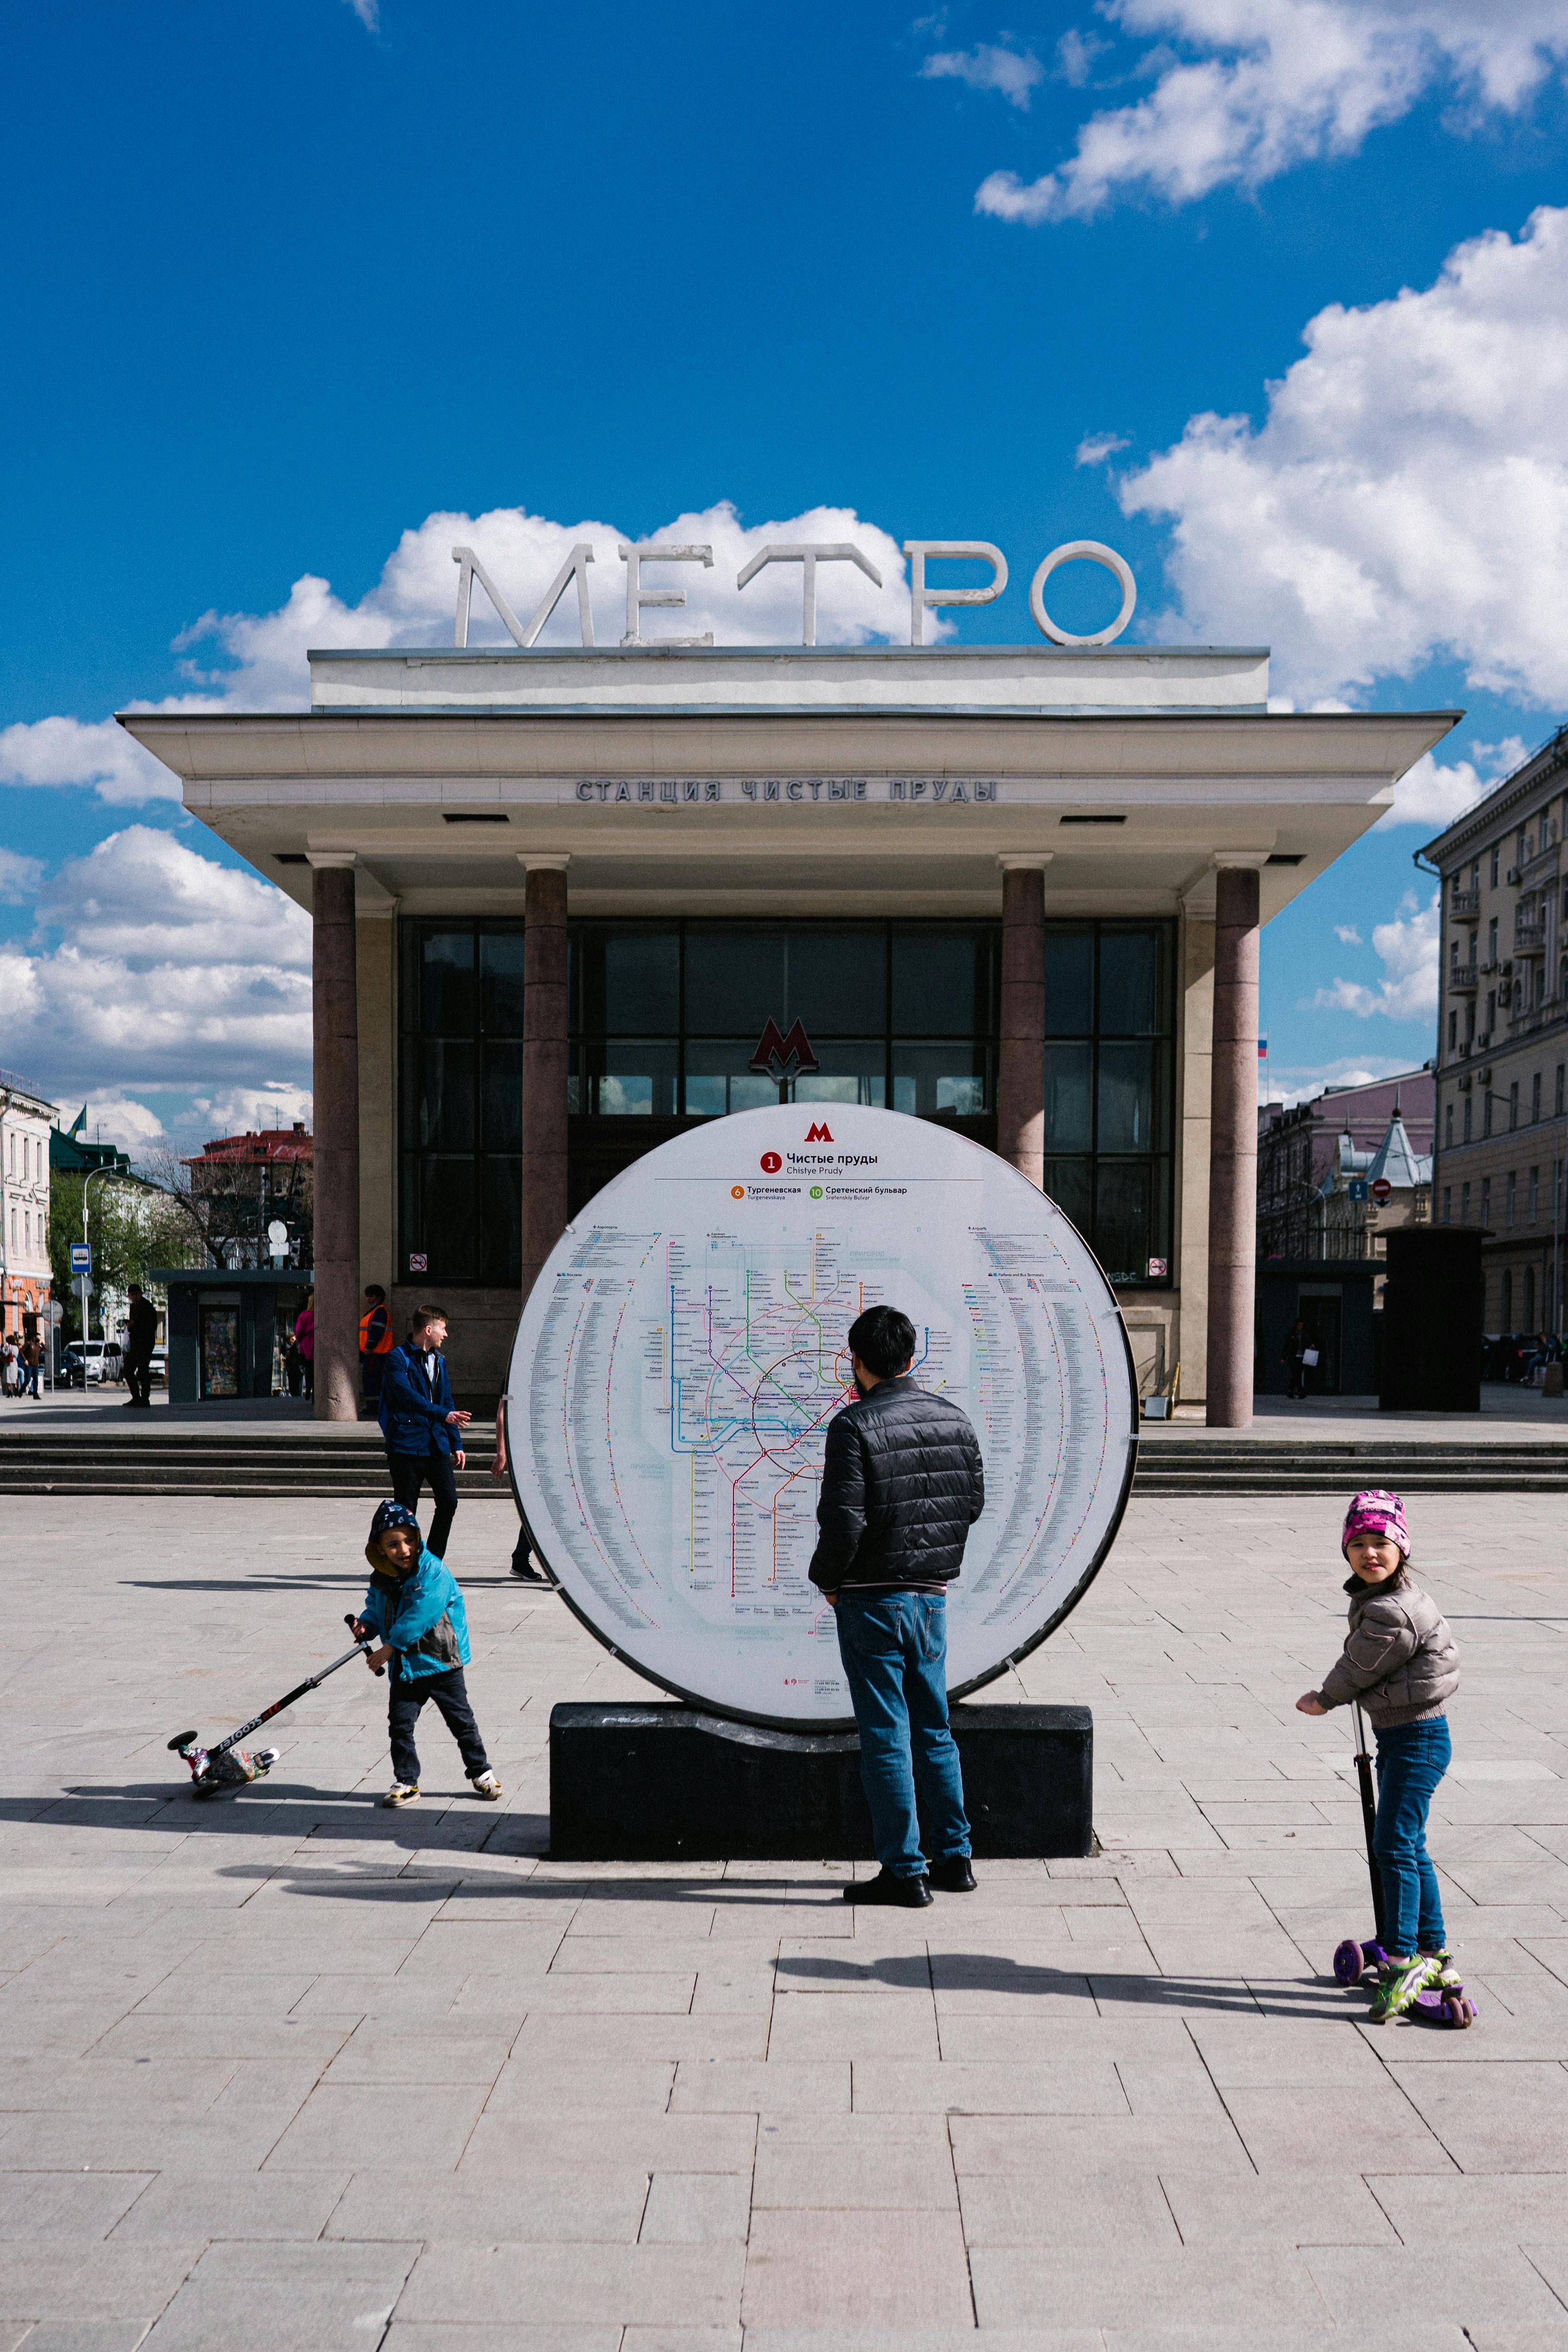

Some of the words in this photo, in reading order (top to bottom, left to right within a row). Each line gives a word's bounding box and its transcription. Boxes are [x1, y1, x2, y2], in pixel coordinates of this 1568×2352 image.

[452, 539, 1136, 648] МЕТРО
[577, 780, 720, 803] СТАНЦИЯ
[742, 780, 866, 800] ЧИСТЫЕ
[890, 780, 997, 803] ПРУДЫ
[767, 1156, 775, 1168] 1
[787, 1153, 834, 1163] Чистые
[837, 1155, 878, 1166] пруды
[787, 1167, 816, 1175] Chistye
[819, 1167, 843, 1175] Prudy
[875, 1186, 907, 1195] бульвар
